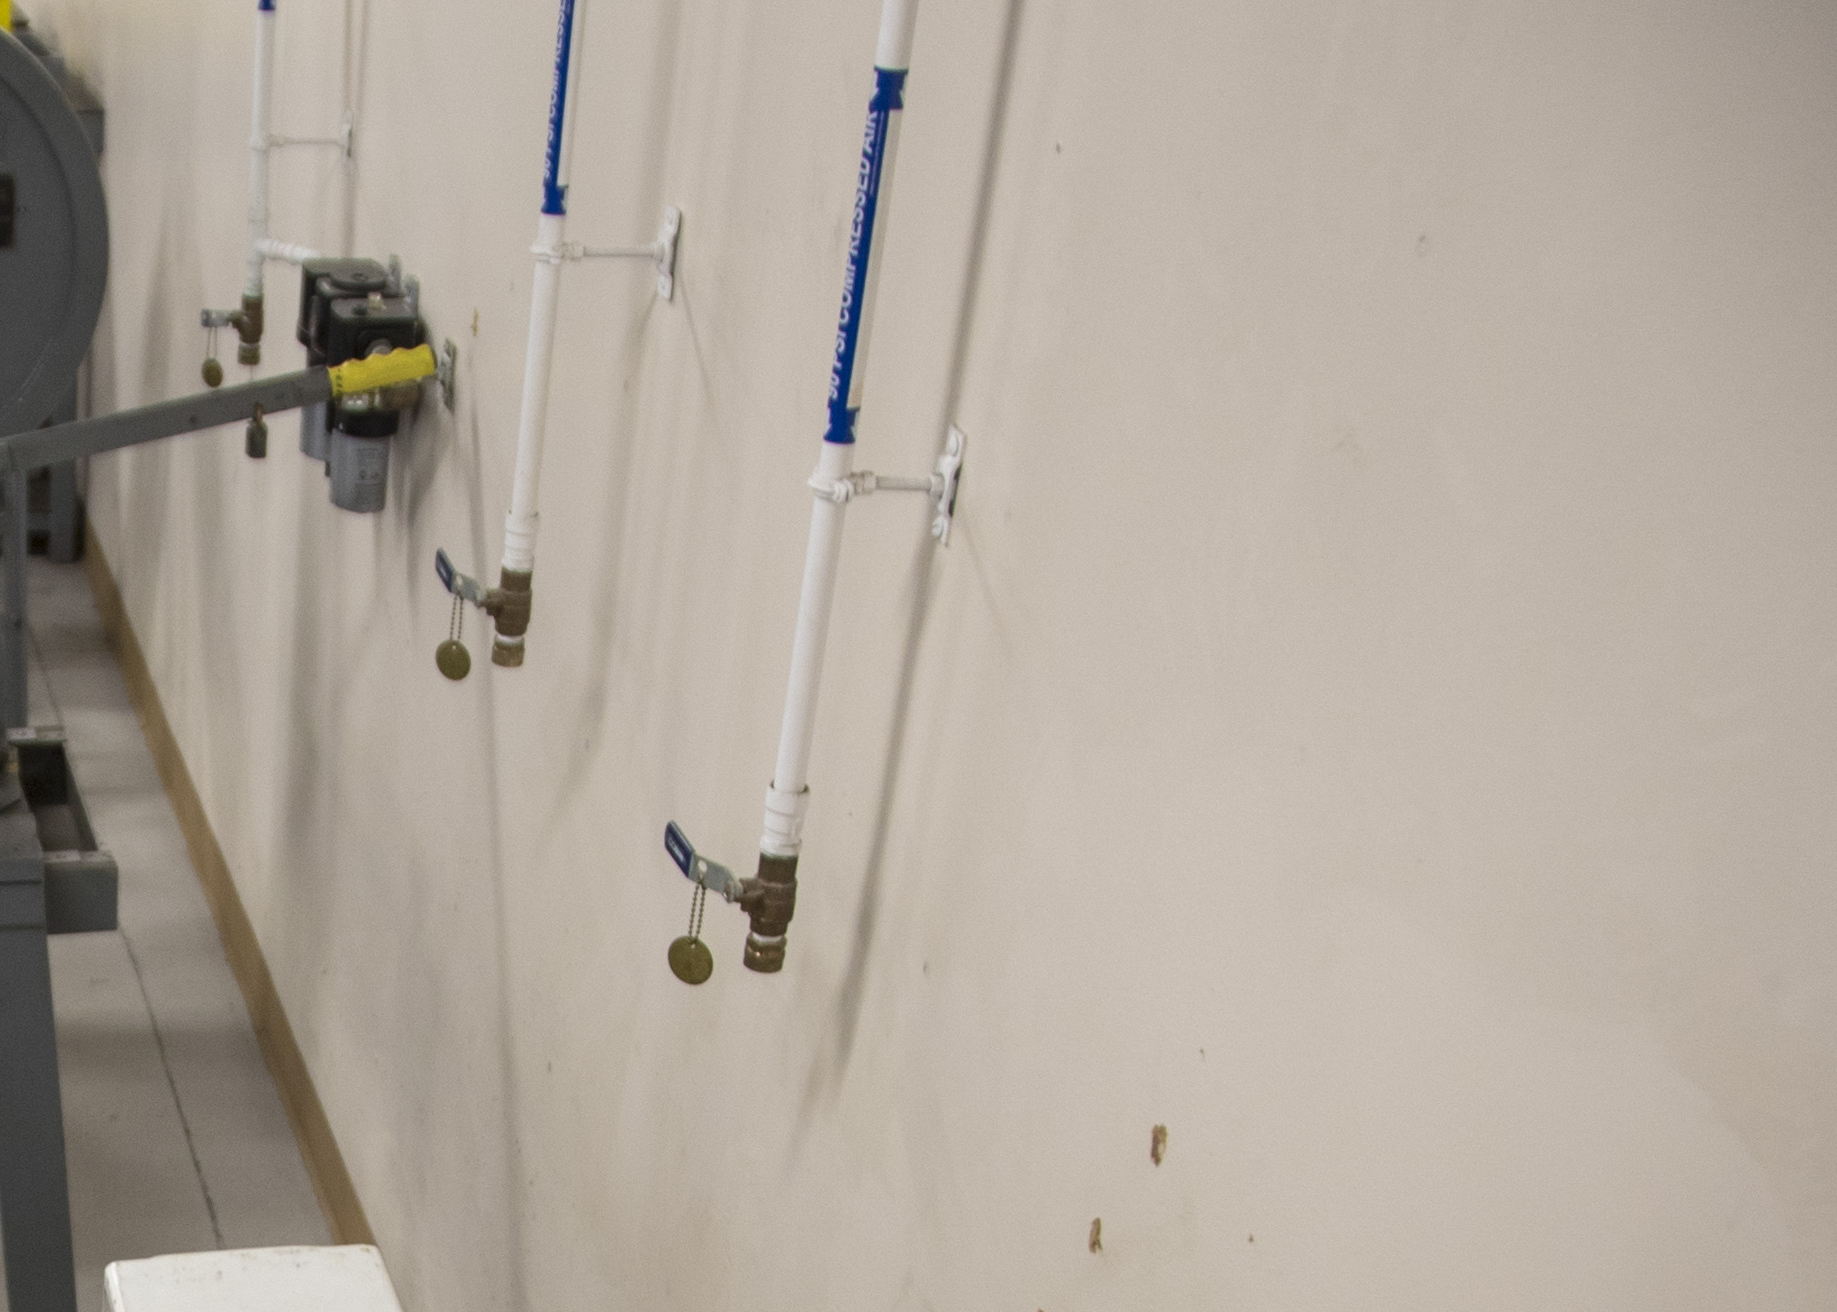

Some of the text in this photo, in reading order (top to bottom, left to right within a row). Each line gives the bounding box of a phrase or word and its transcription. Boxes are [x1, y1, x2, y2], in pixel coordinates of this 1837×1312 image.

[862, 111, 878, 154] AIR
[839, 157, 872, 325] COMPRESSED
[833, 331, 848, 369] PSI
